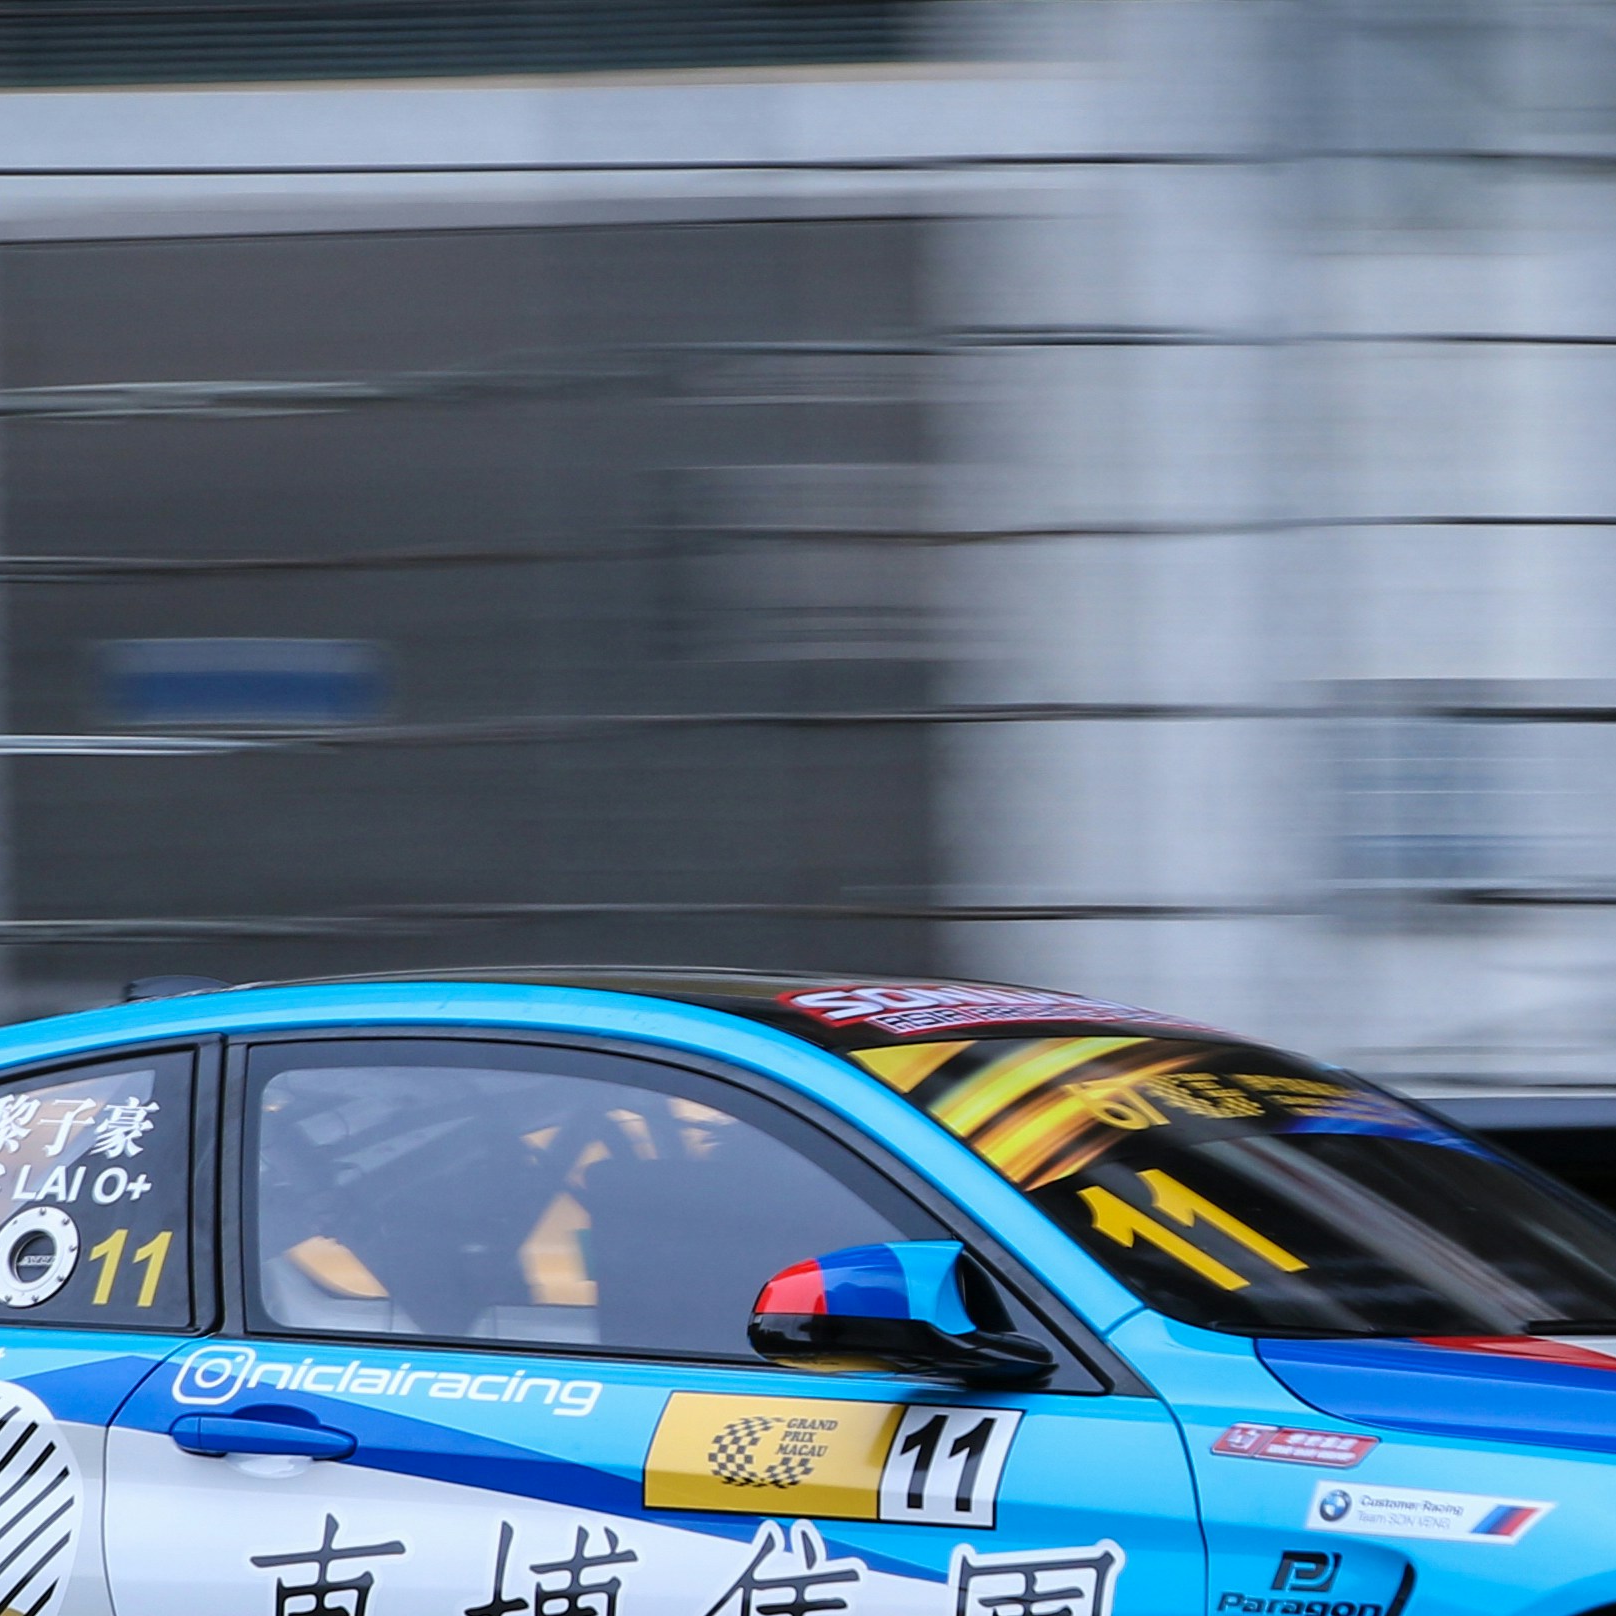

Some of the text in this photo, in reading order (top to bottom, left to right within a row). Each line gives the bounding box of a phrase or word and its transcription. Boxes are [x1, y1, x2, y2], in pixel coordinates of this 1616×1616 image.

[11, 1165, 87, 1203] LAI
[91, 1166, 152, 1206] O+
[1076, 1168, 1311, 1292] 11
[88, 1228, 173, 1308] 11
[245, 1357, 604, 1418] niclairacing
[780, 1430, 815, 1444] PRIX
[785, 1417, 839, 1431] GRAND
[775, 1443, 829, 1458] MACAU
[899, 1413, 998, 1514] 11
